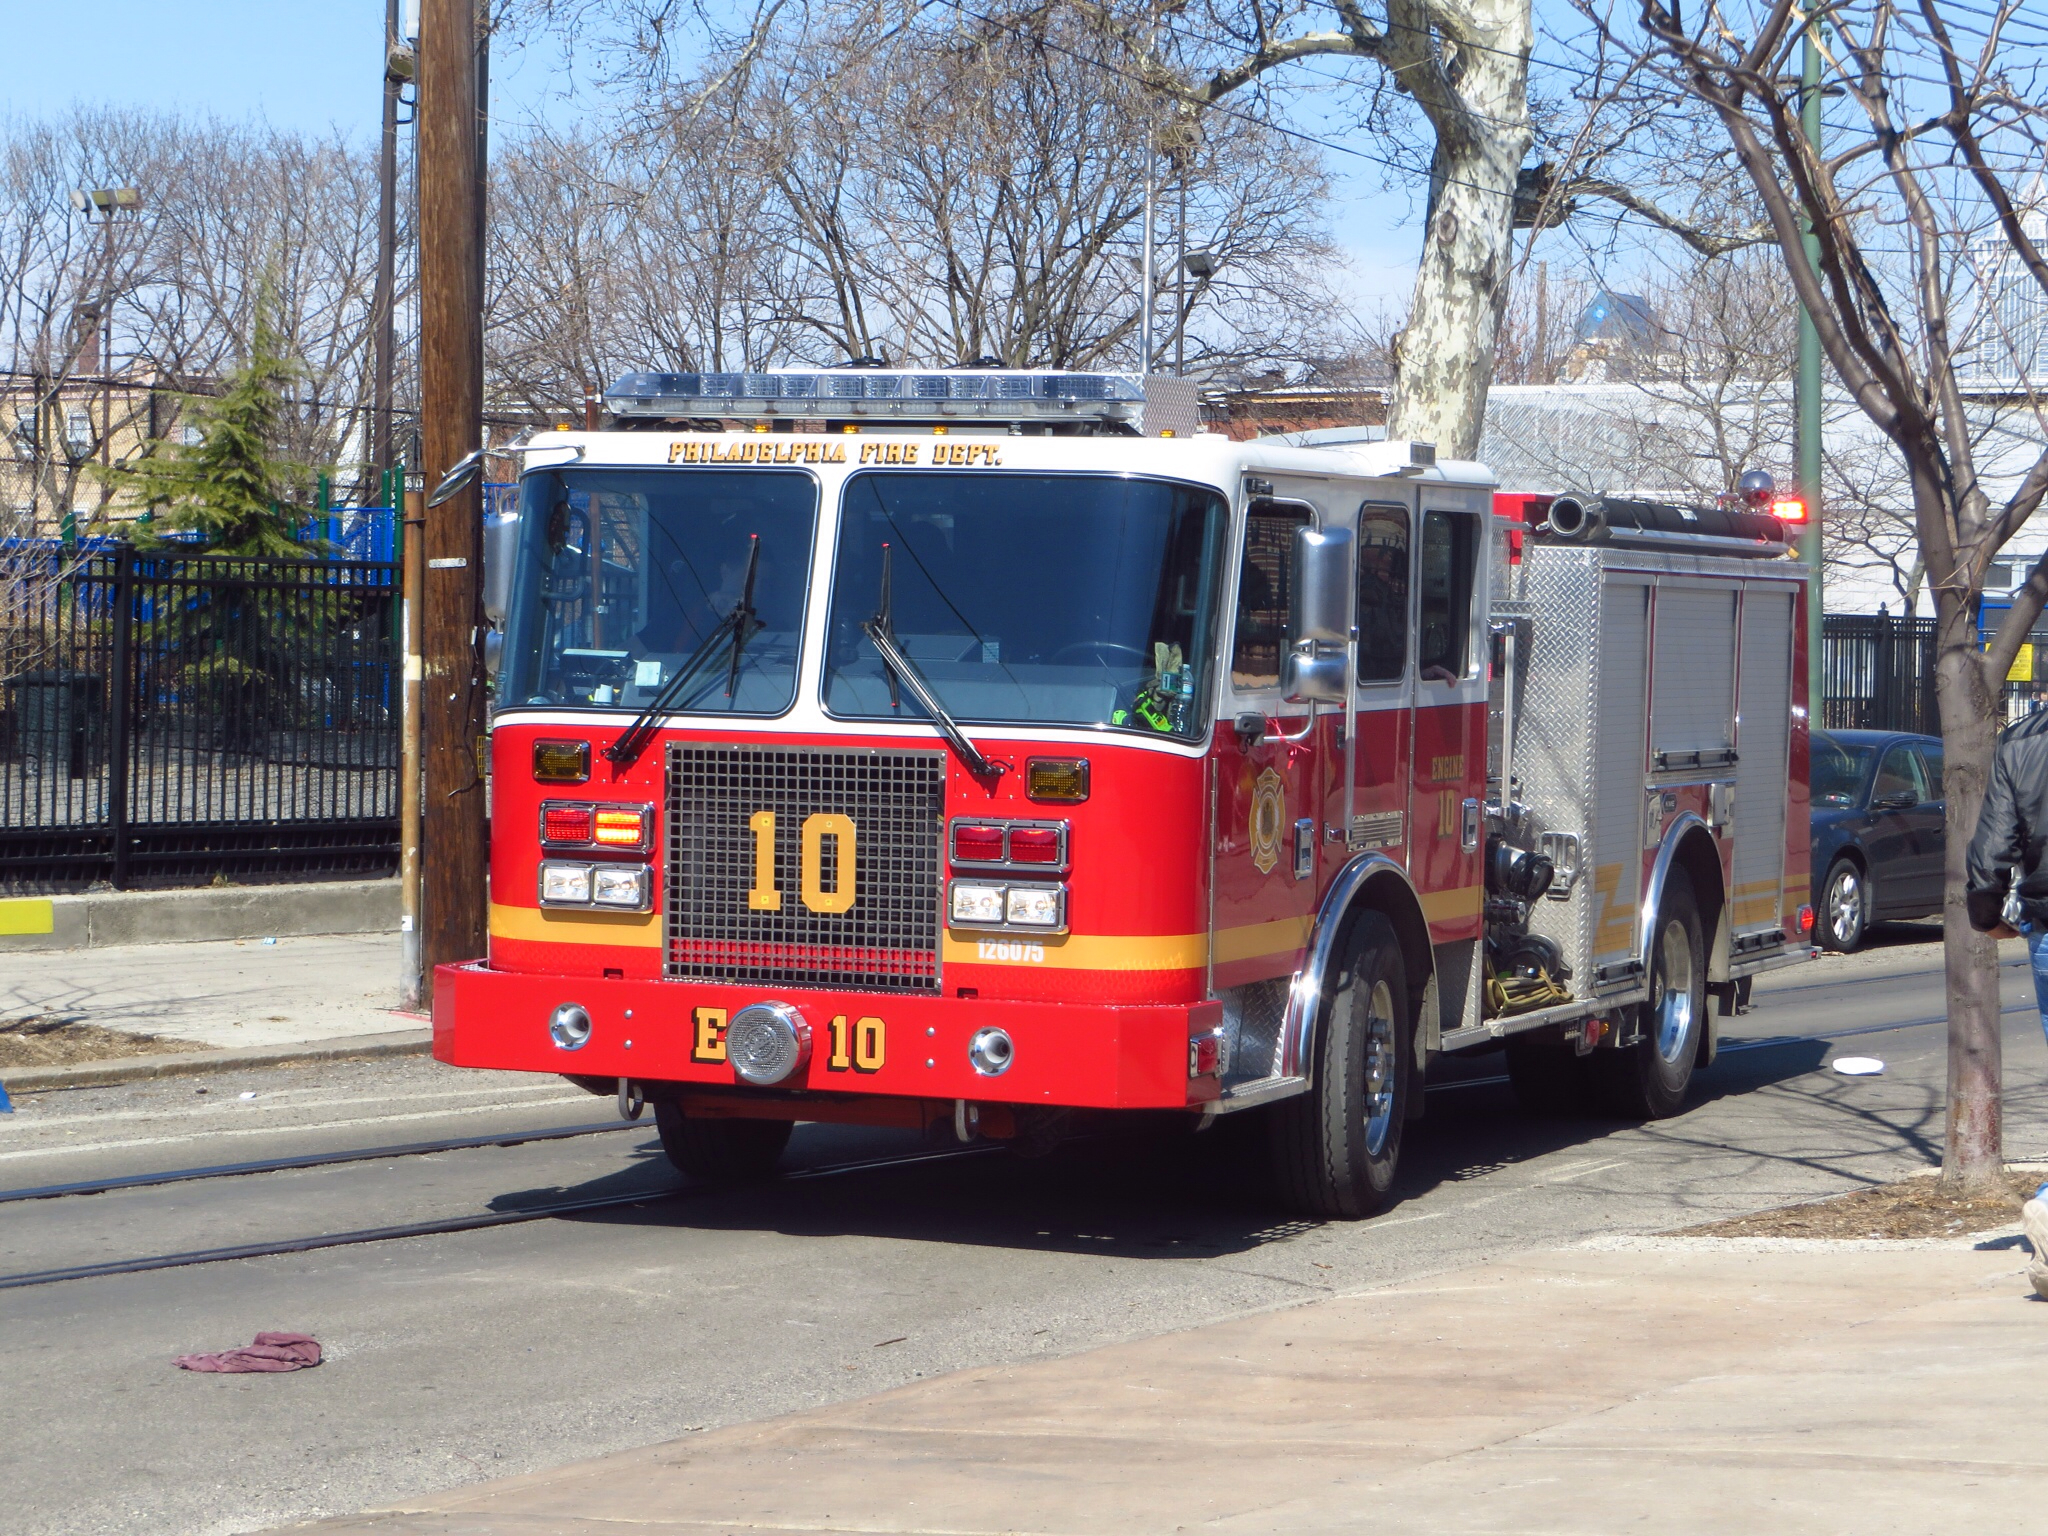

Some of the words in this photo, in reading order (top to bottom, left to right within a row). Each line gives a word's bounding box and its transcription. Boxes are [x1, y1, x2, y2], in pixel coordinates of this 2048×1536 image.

[668, 442, 848, 464] PHILADELPHIA
[859, 443, 919, 464] FIRE
[931, 443, 1003, 466] DEPT.
[1431, 755, 1464, 782] ENGINE
[1438, 789, 1455, 838] 10
[748, 811, 857, 914] 10
[977, 938, 1044, 962] 126075
[691, 1006, 727, 1065] E
[827, 1014, 887, 1075] 10
